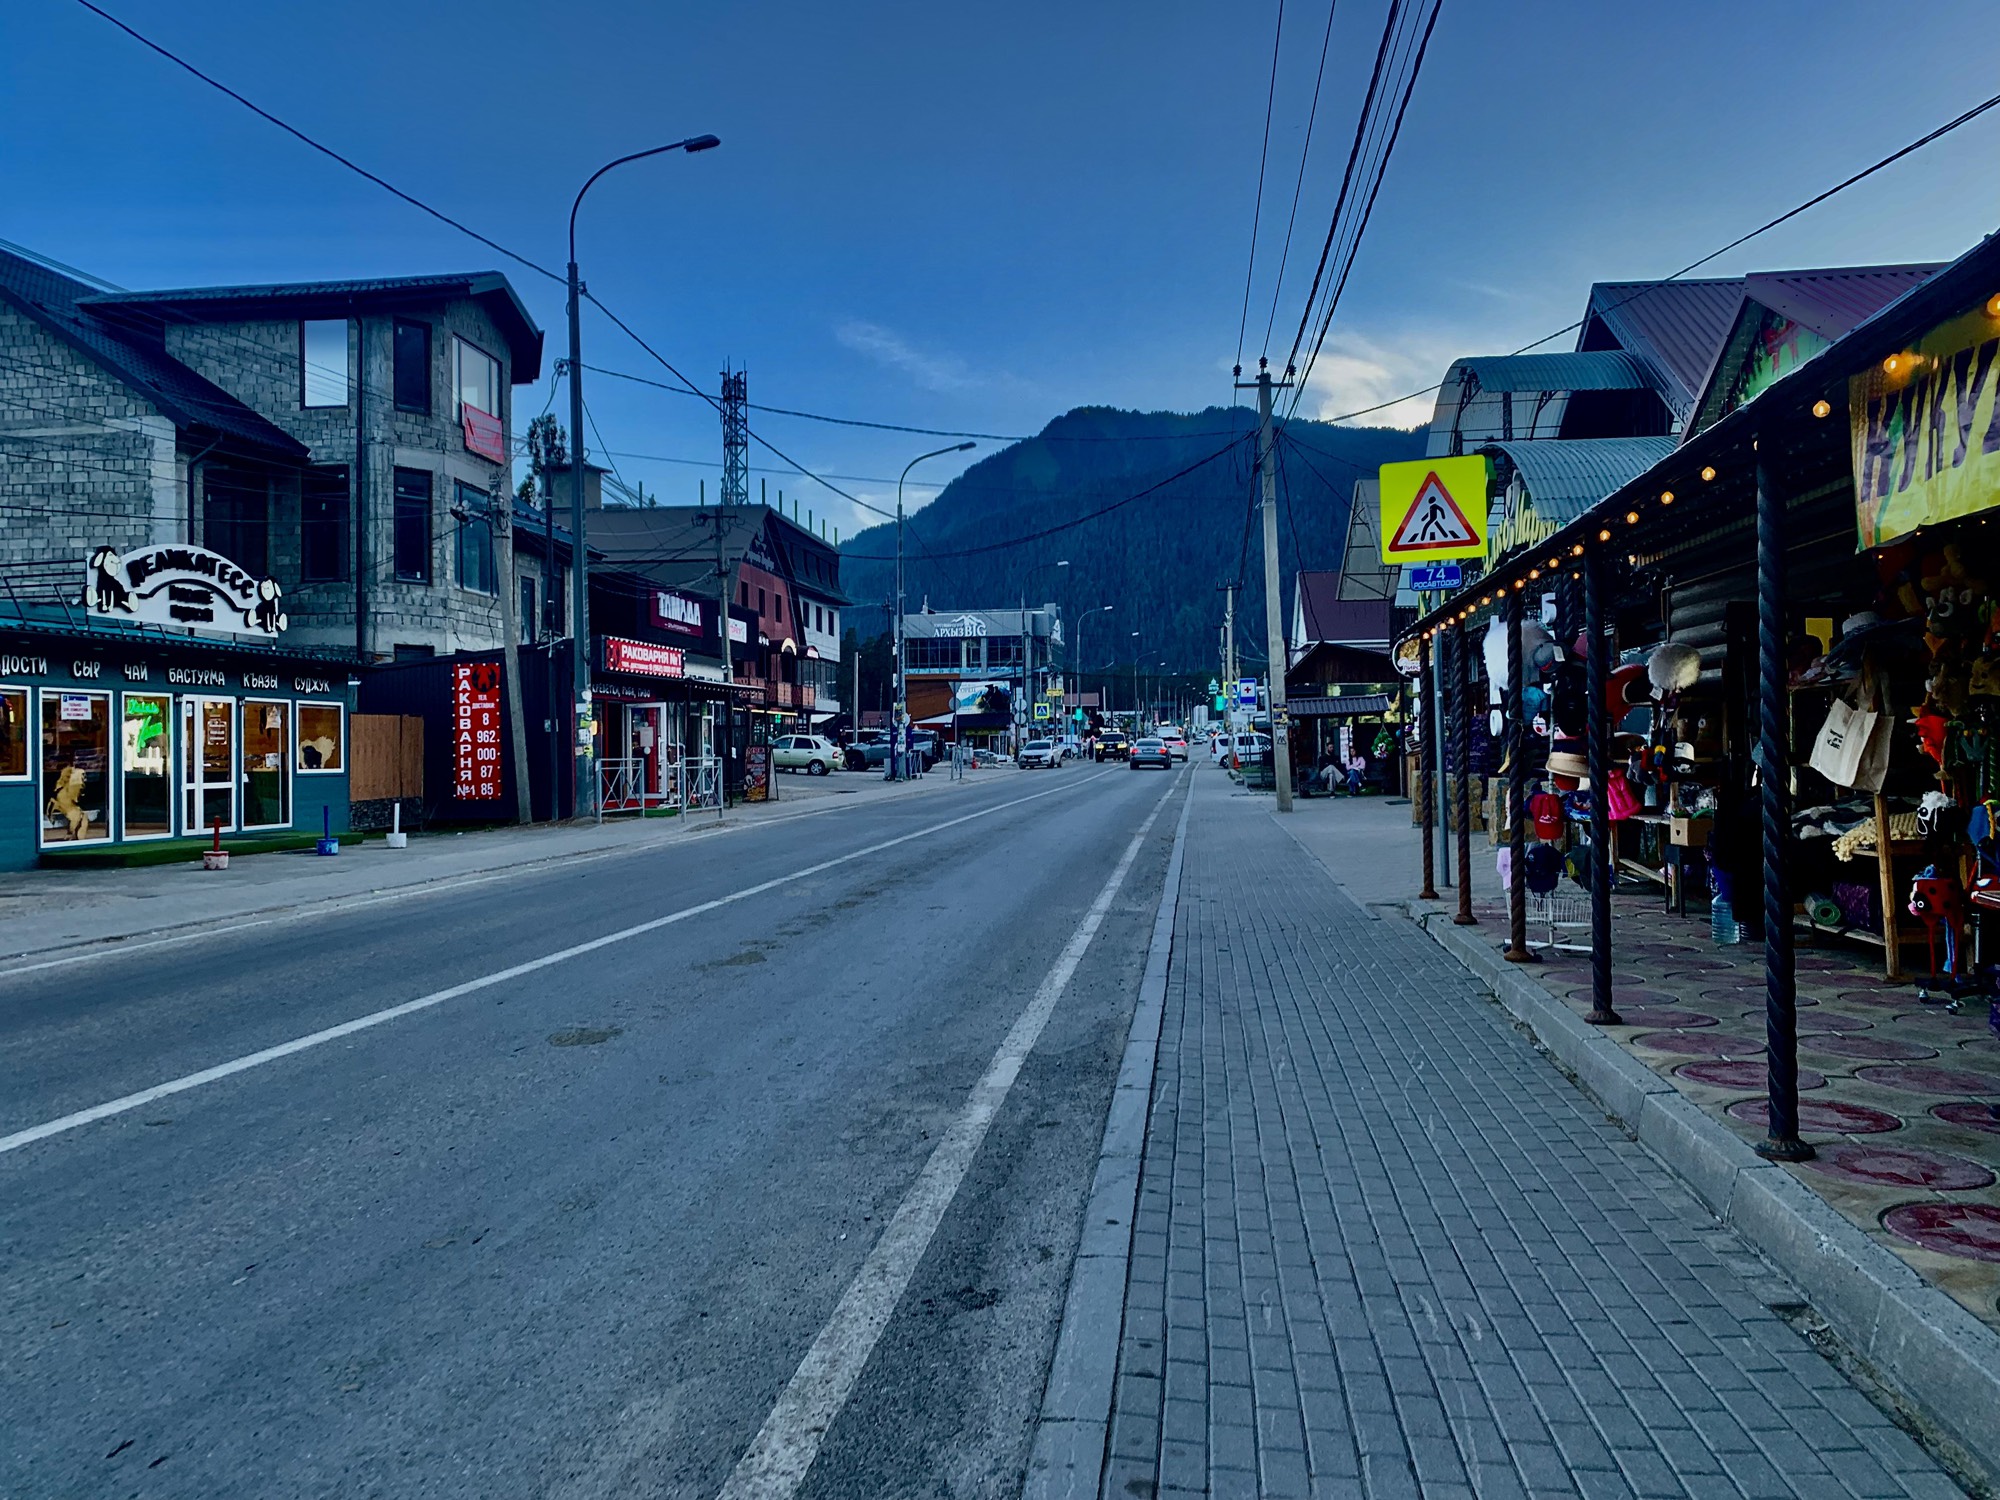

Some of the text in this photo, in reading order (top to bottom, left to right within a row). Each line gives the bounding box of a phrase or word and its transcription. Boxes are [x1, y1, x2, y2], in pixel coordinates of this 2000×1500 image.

[1426, 568, 1446, 580] 74
[1413, 579, 1460, 589] РОСАВТОДОР
[934, 628, 963, 637] АРХЫЗ
[964, 624, 987, 637] BIG
[621, 644, 682, 666] РАКОВАРНЯ №1
[73, 661, 100, 678] СЫР
[124, 661, 148, 681] ЧАЙ
[168, 668, 225, 686] БАСТУРМА
[243, 673, 278, 689] КЪАЗЫ
[294, 677, 330, 693] СУДЖУК
[458, 668, 472, 781] РАКОВАРНЯ
[482, 712, 489, 726] 8
[477, 730, 496, 743] 962
[477, 748, 496, 760] 000
[480, 765, 493, 778] 87
[457, 784, 476, 796] №1
[481, 783, 494, 796] 85
